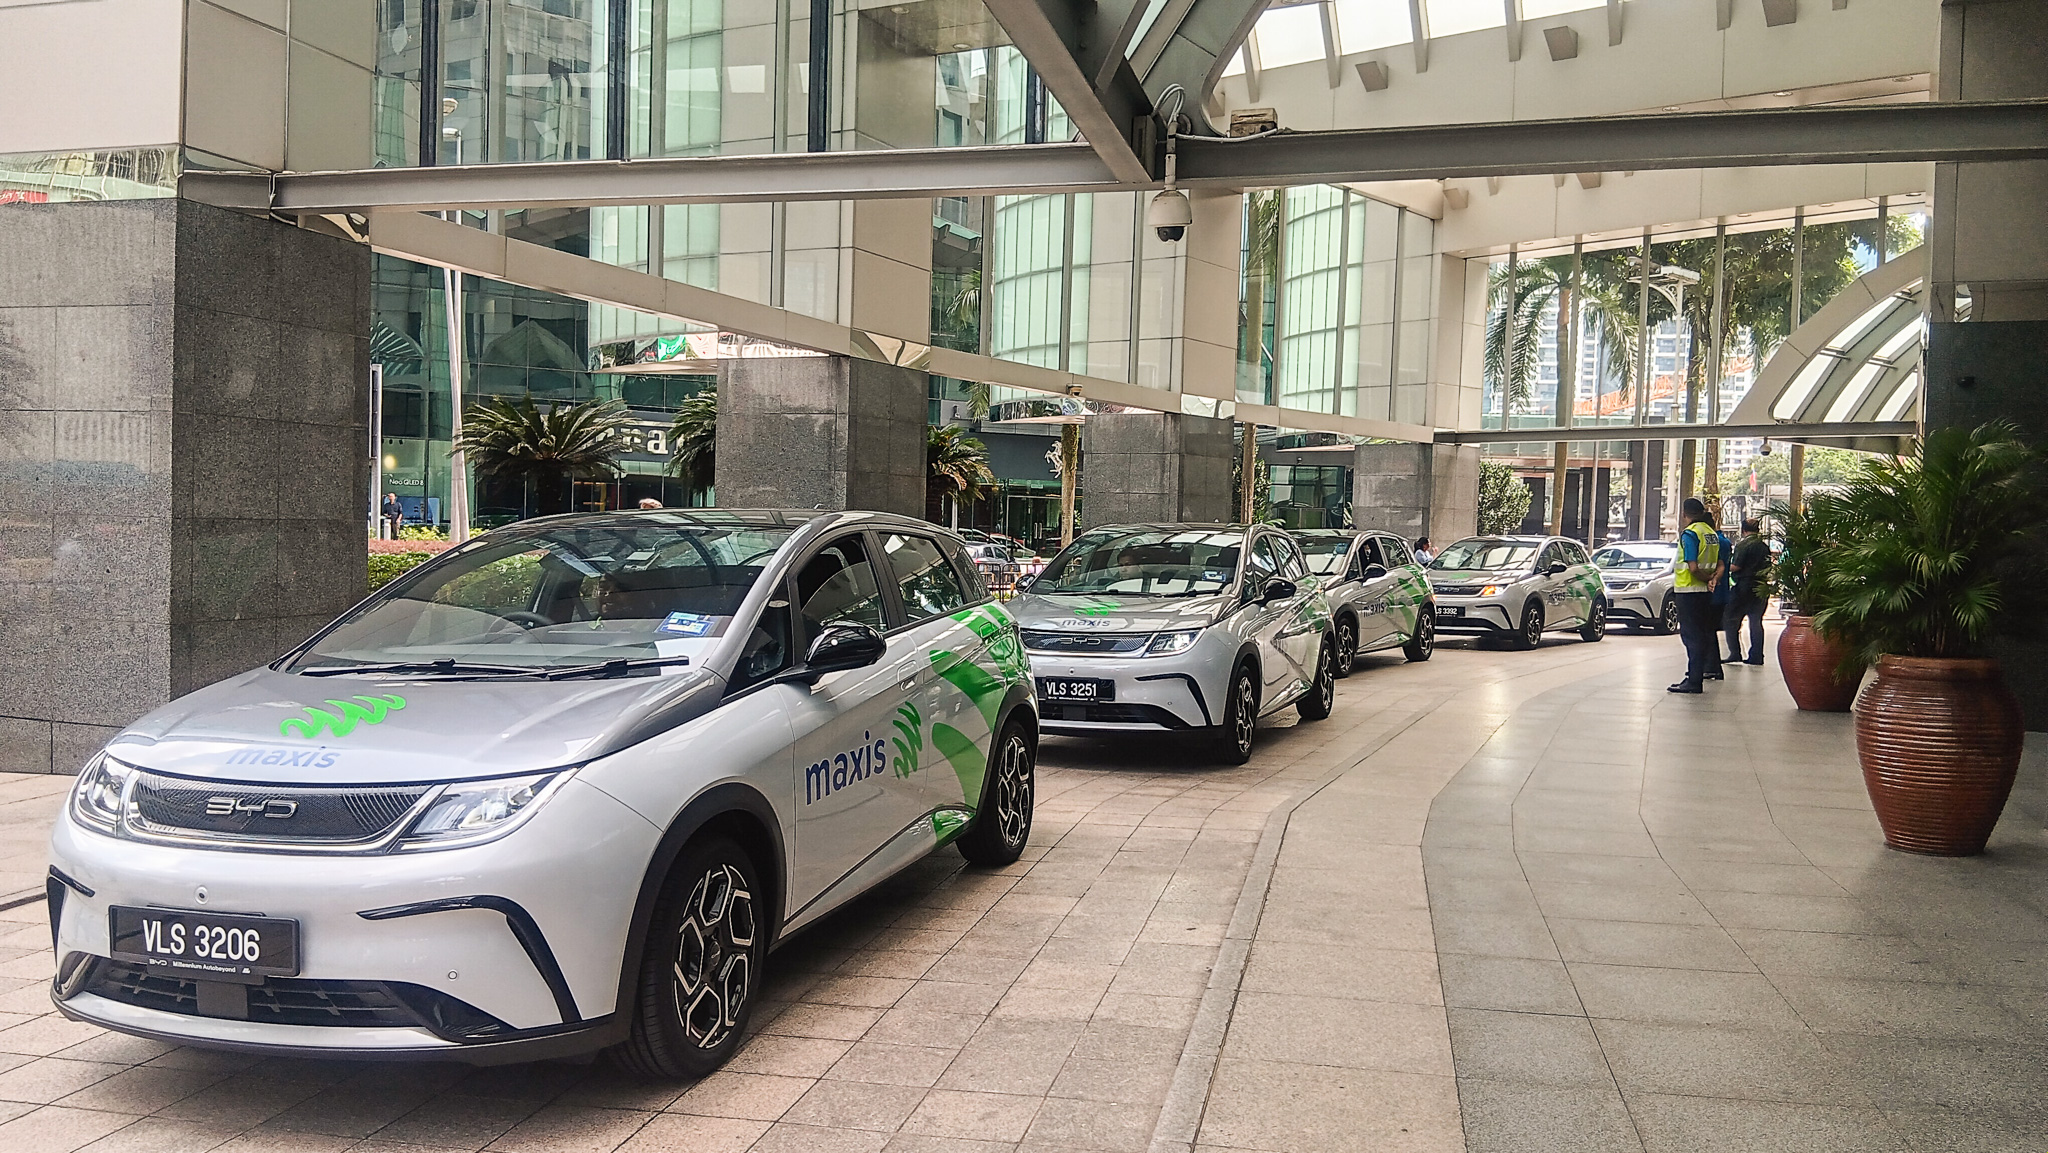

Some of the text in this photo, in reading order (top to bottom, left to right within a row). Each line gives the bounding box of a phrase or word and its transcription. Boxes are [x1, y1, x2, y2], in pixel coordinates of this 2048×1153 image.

[1363, 598, 1386, 618] maxis
[1061, 618, 1111, 627] maxis
[1060, 637, 1101, 645] BYD
[1046, 681, 1097, 697] VLS 3251
[226, 745, 342, 769] maxis
[805, 730, 887, 806] maxis
[205, 796, 300, 819] BYD
[143, 919, 262, 962] VLS 3206
[149, 958, 237, 973] BYD Millennium Autobeyond
